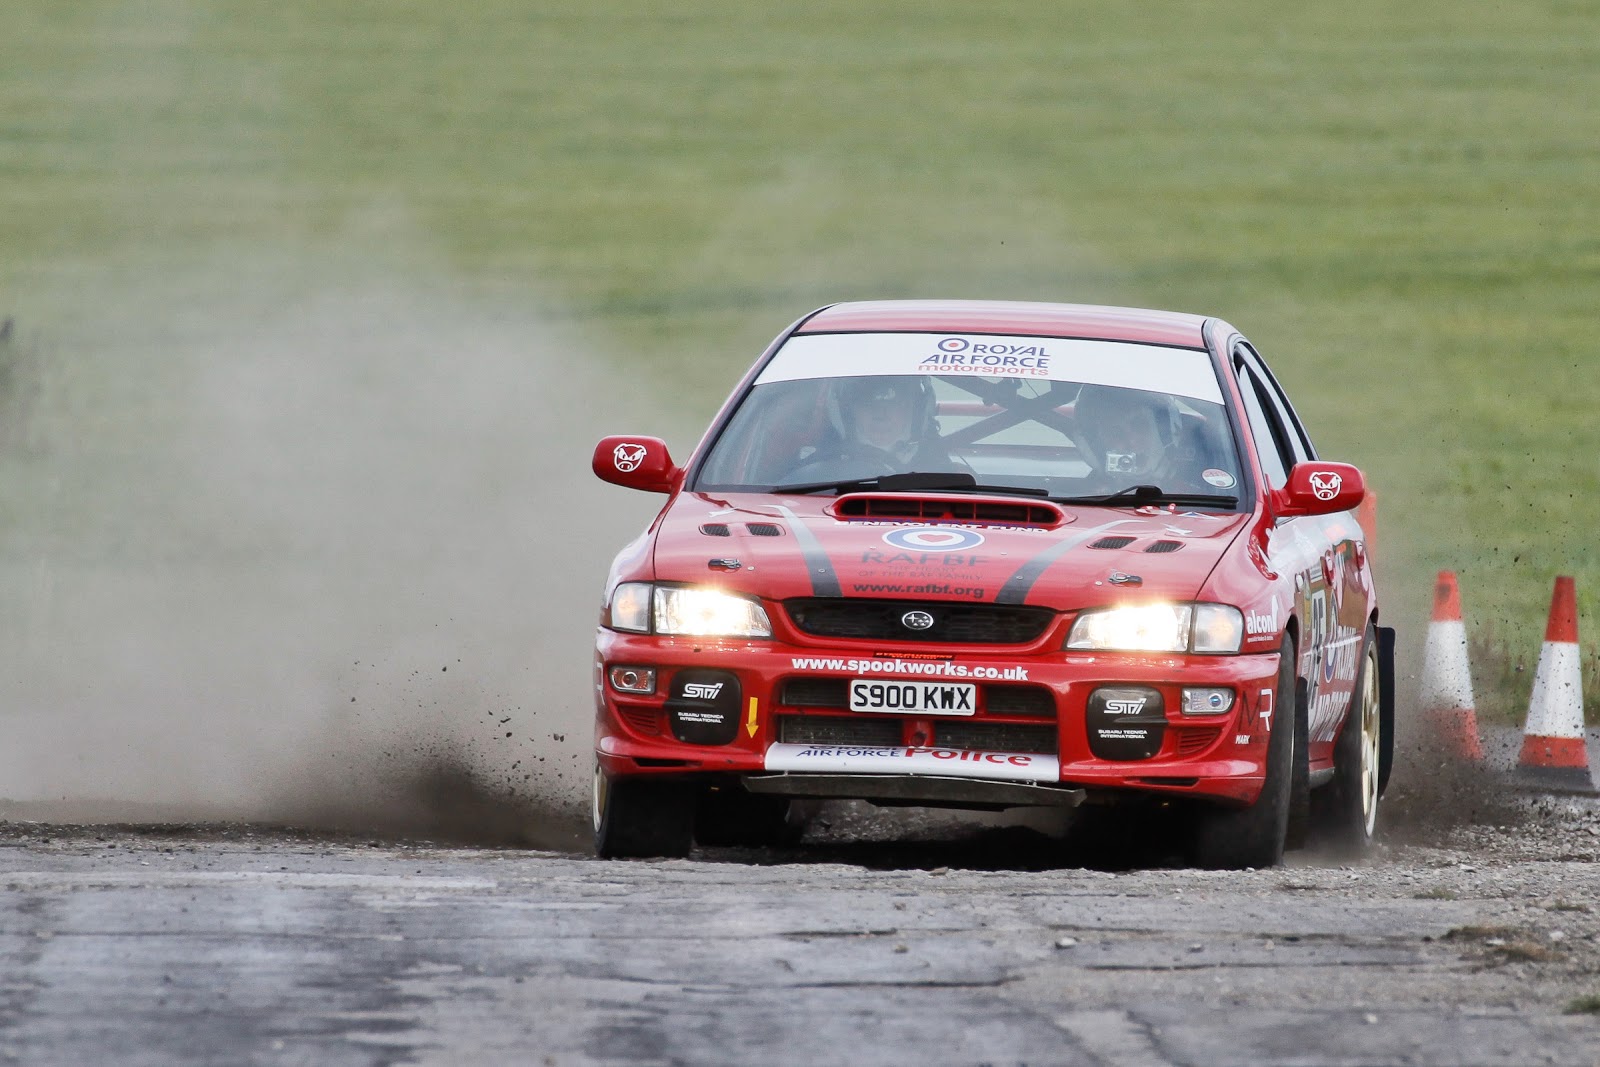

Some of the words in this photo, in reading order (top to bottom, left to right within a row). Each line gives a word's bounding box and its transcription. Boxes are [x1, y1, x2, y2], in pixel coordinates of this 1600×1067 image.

[972, 344, 1051, 357] ROYAL
[921, 354, 966, 365] AIR
[970, 355, 1050, 369] FORCE
[918, 364, 1049, 376] motorsports
[861, 551, 990, 567] RAFBF
[853, 583, 985, 599] www.rafbf.org
[1247, 609, 1273, 635] alcon
[791, 658, 1030, 681] www.spookworks.co.uk
[853, 684, 917, 709] S900
[924, 686, 972, 711] KWX
[796, 749, 832, 757] AIR
[836, 749, 901, 758] FORCE
[904, 747, 1033, 767] Police
